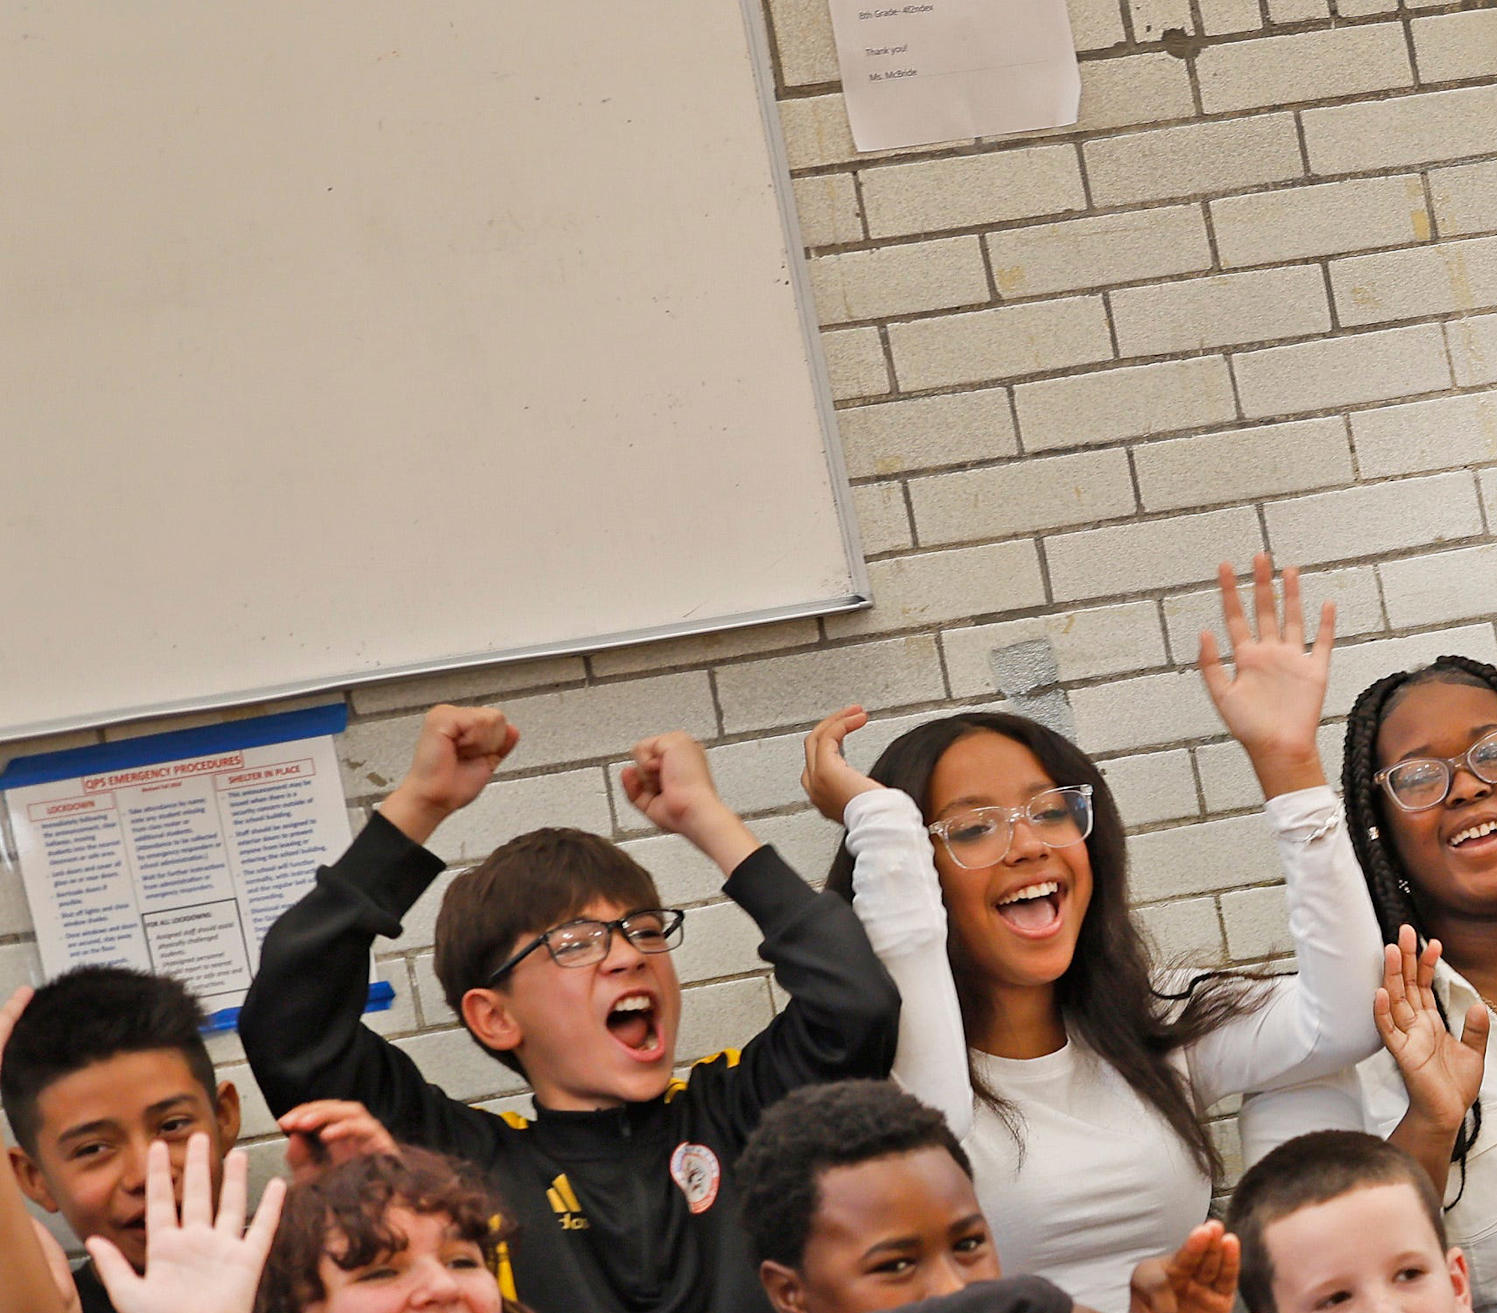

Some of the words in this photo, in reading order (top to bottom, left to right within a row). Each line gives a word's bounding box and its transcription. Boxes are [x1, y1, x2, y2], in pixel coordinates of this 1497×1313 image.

[865, 47, 889, 55] Thank
[891, 44, 908, 55] you!
[885, 69, 918, 79] McBride
[108, 768, 171, 785] EMERGENCY
[174, 756, 242, 773] PROCEDURES
[228, 772, 262, 784] SHELTER
[276, 765, 300, 776] PLACE
[47, 800, 95, 814] LOCKDOWN
